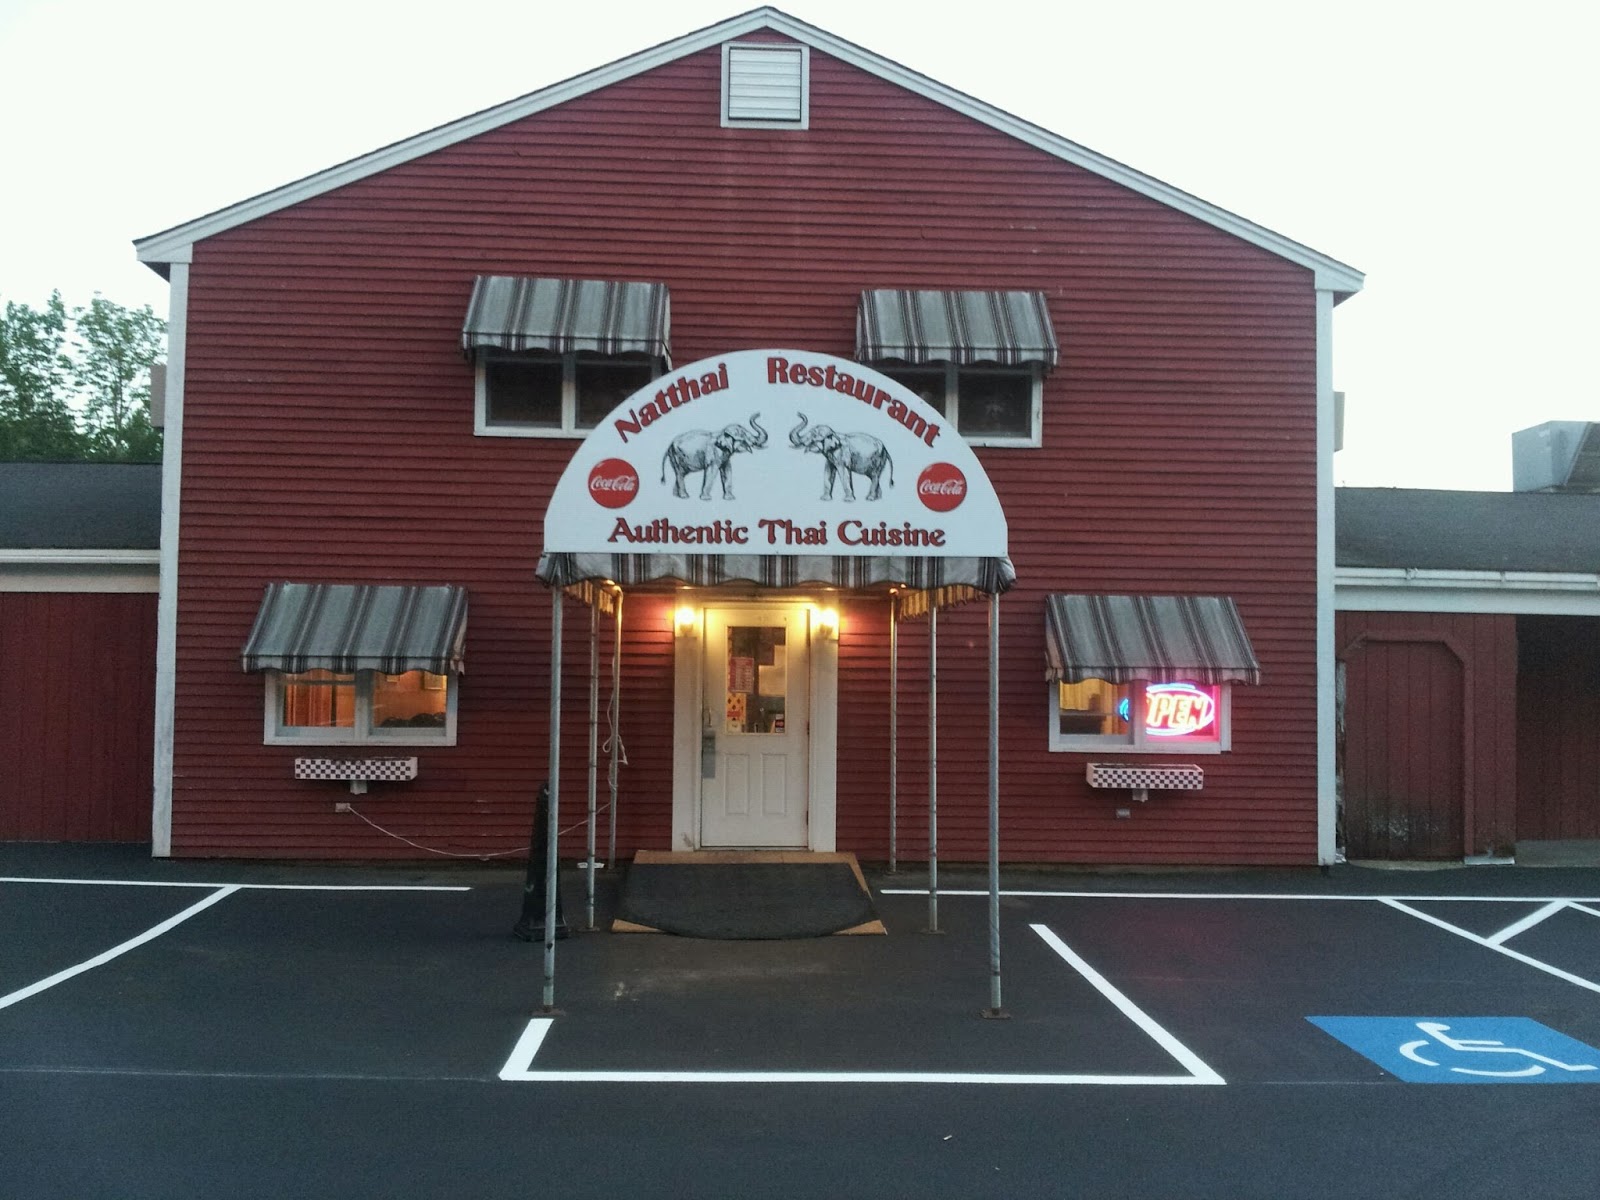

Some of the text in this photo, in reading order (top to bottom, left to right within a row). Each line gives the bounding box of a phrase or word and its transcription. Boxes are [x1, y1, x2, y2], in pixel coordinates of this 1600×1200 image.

[614, 357, 941, 448] Natthai Restaurant
[607, 517, 945, 547] Authentic Thai Cuisine
